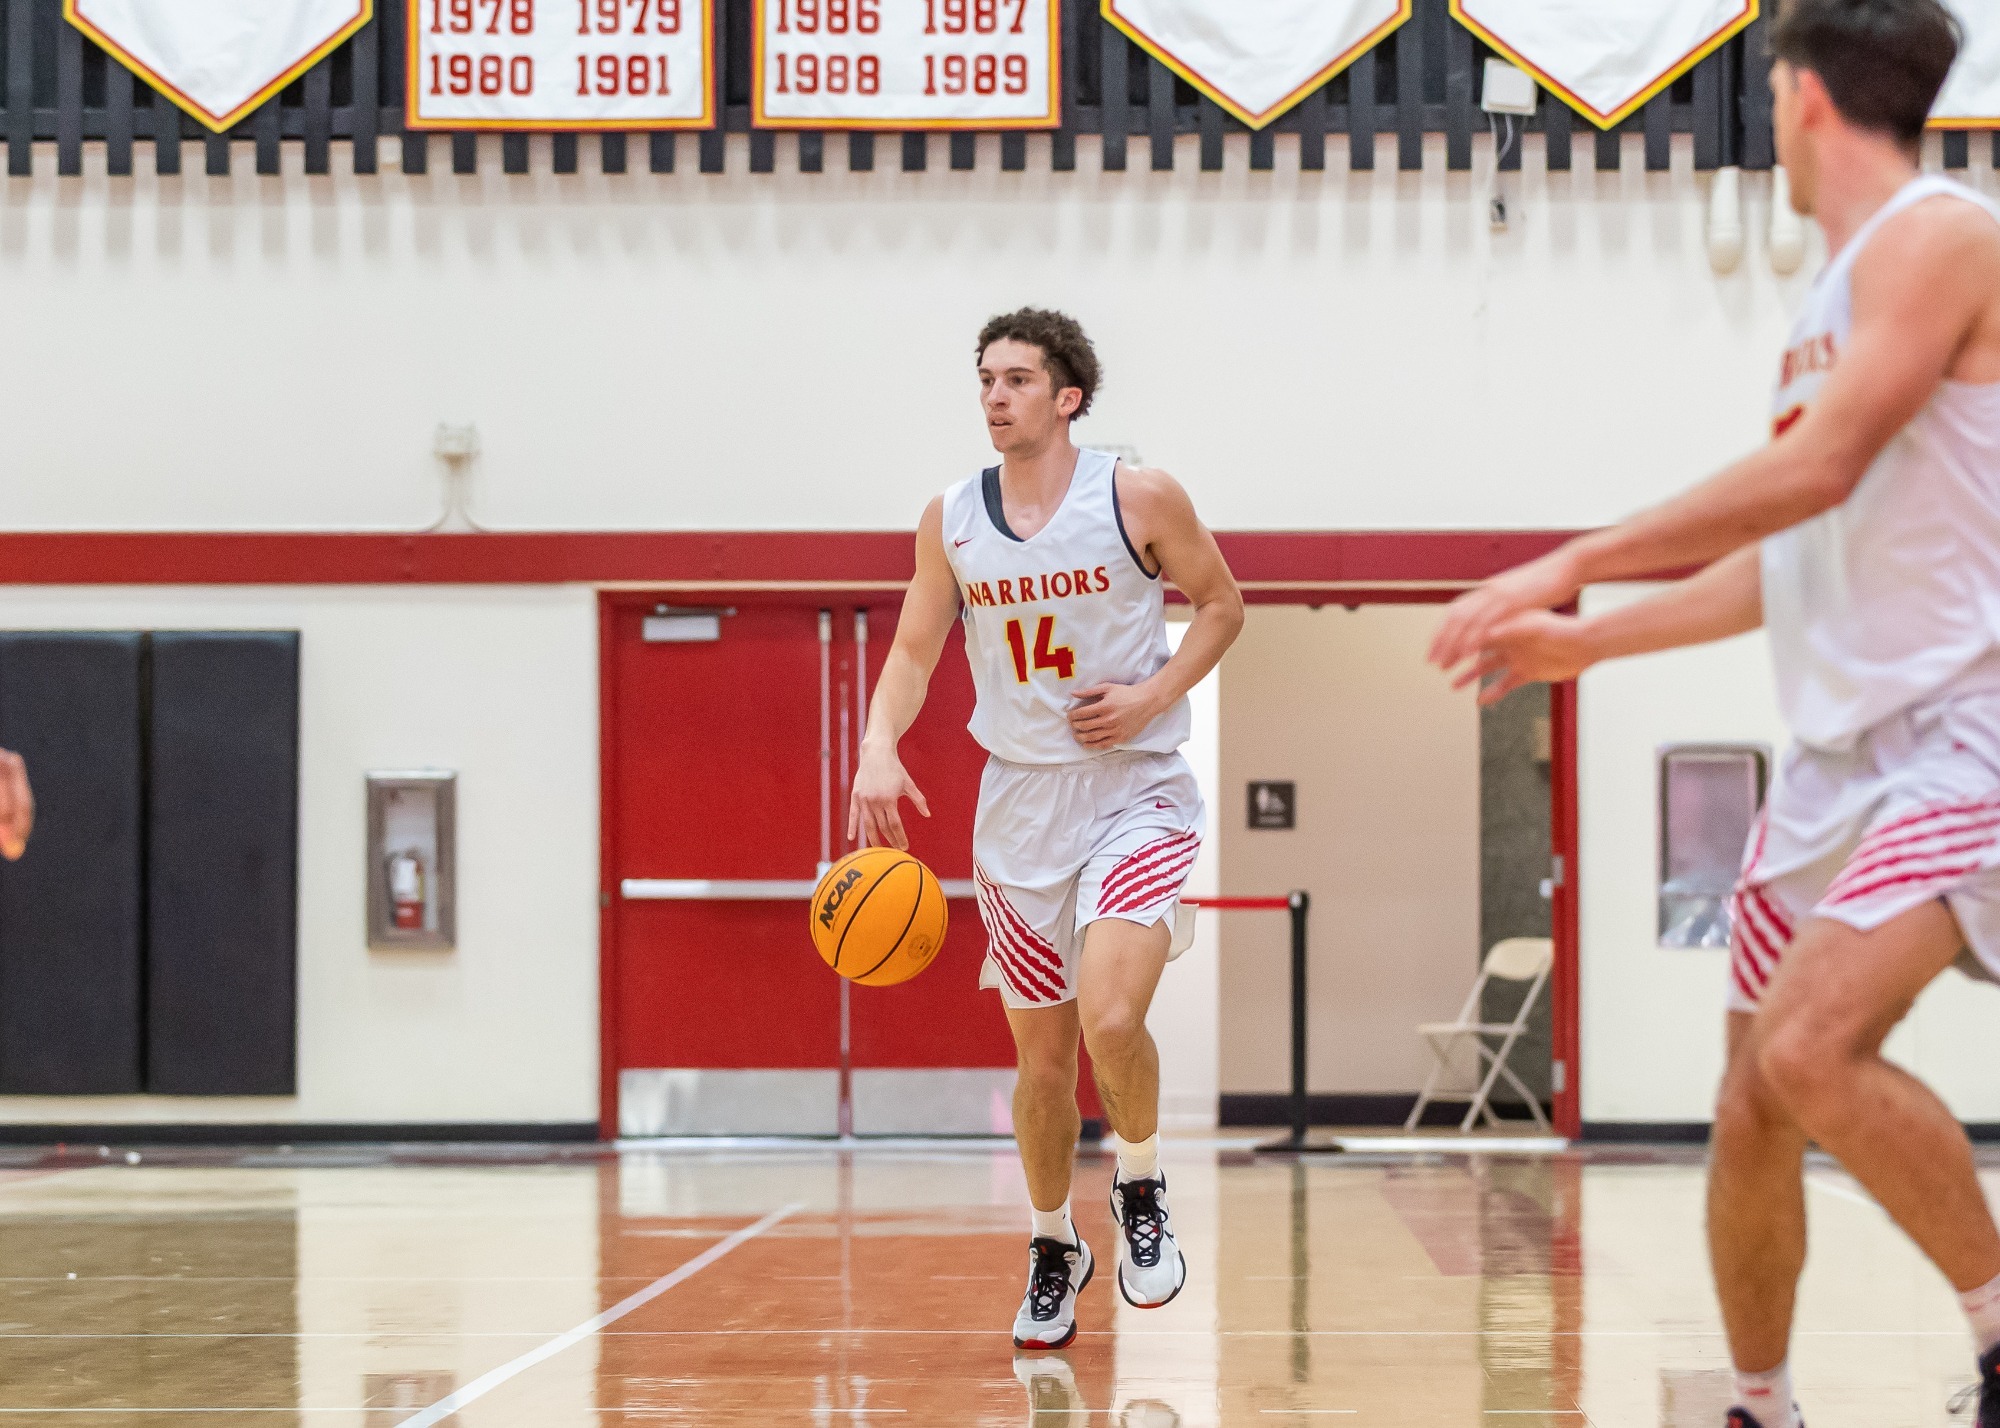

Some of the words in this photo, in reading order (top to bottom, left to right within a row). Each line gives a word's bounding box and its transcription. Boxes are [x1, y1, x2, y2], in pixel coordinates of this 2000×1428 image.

[429, 0, 534, 34] 1978
[577, 0, 681, 34] 1979
[776, 0, 880, 34] 1986
[924, 0, 1025, 34] 1987
[429, 54, 534, 95] 1980
[576, 54, 671, 95] 1981
[776, 53, 880, 94] 1988
[923, 54, 1027, 95] 1989
[1006, 615, 1075, 684] 14
[819, 868, 863, 931] NCAA
